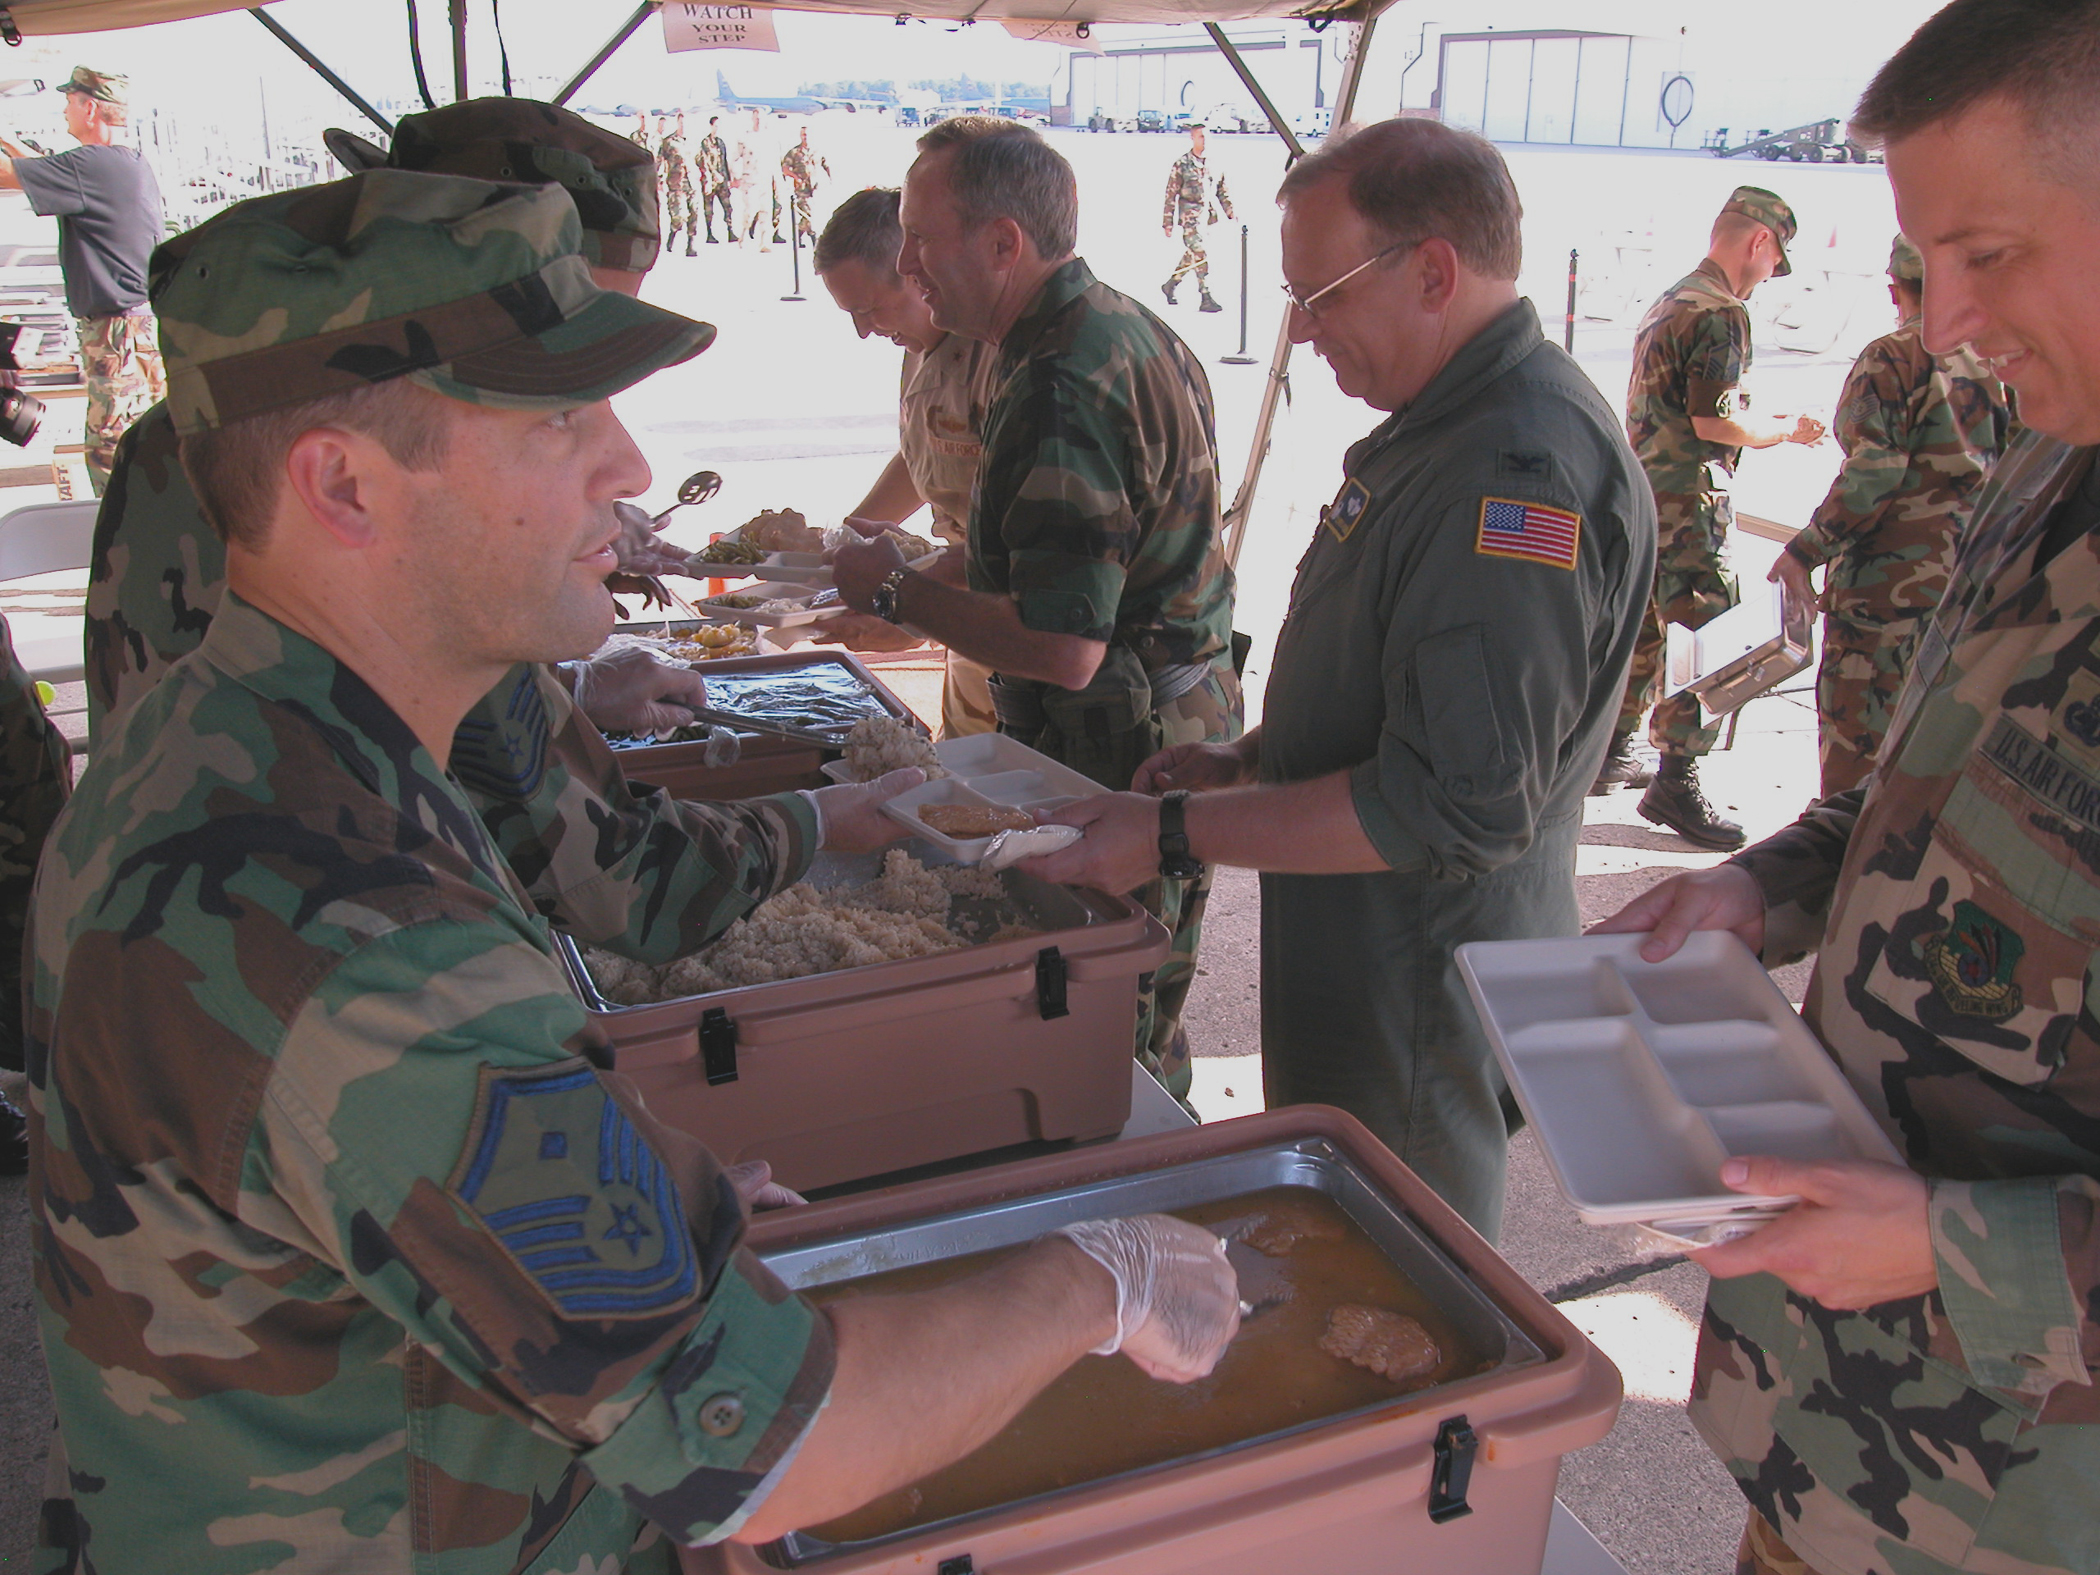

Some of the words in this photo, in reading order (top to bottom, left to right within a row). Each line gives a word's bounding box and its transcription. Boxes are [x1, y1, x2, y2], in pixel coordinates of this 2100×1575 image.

[683, 4, 754, 20] WATCH
[691, 23, 748, 33] YOUR
[698, 34, 746, 44] STEP
[2020, 750, 2061, 795] AIR
